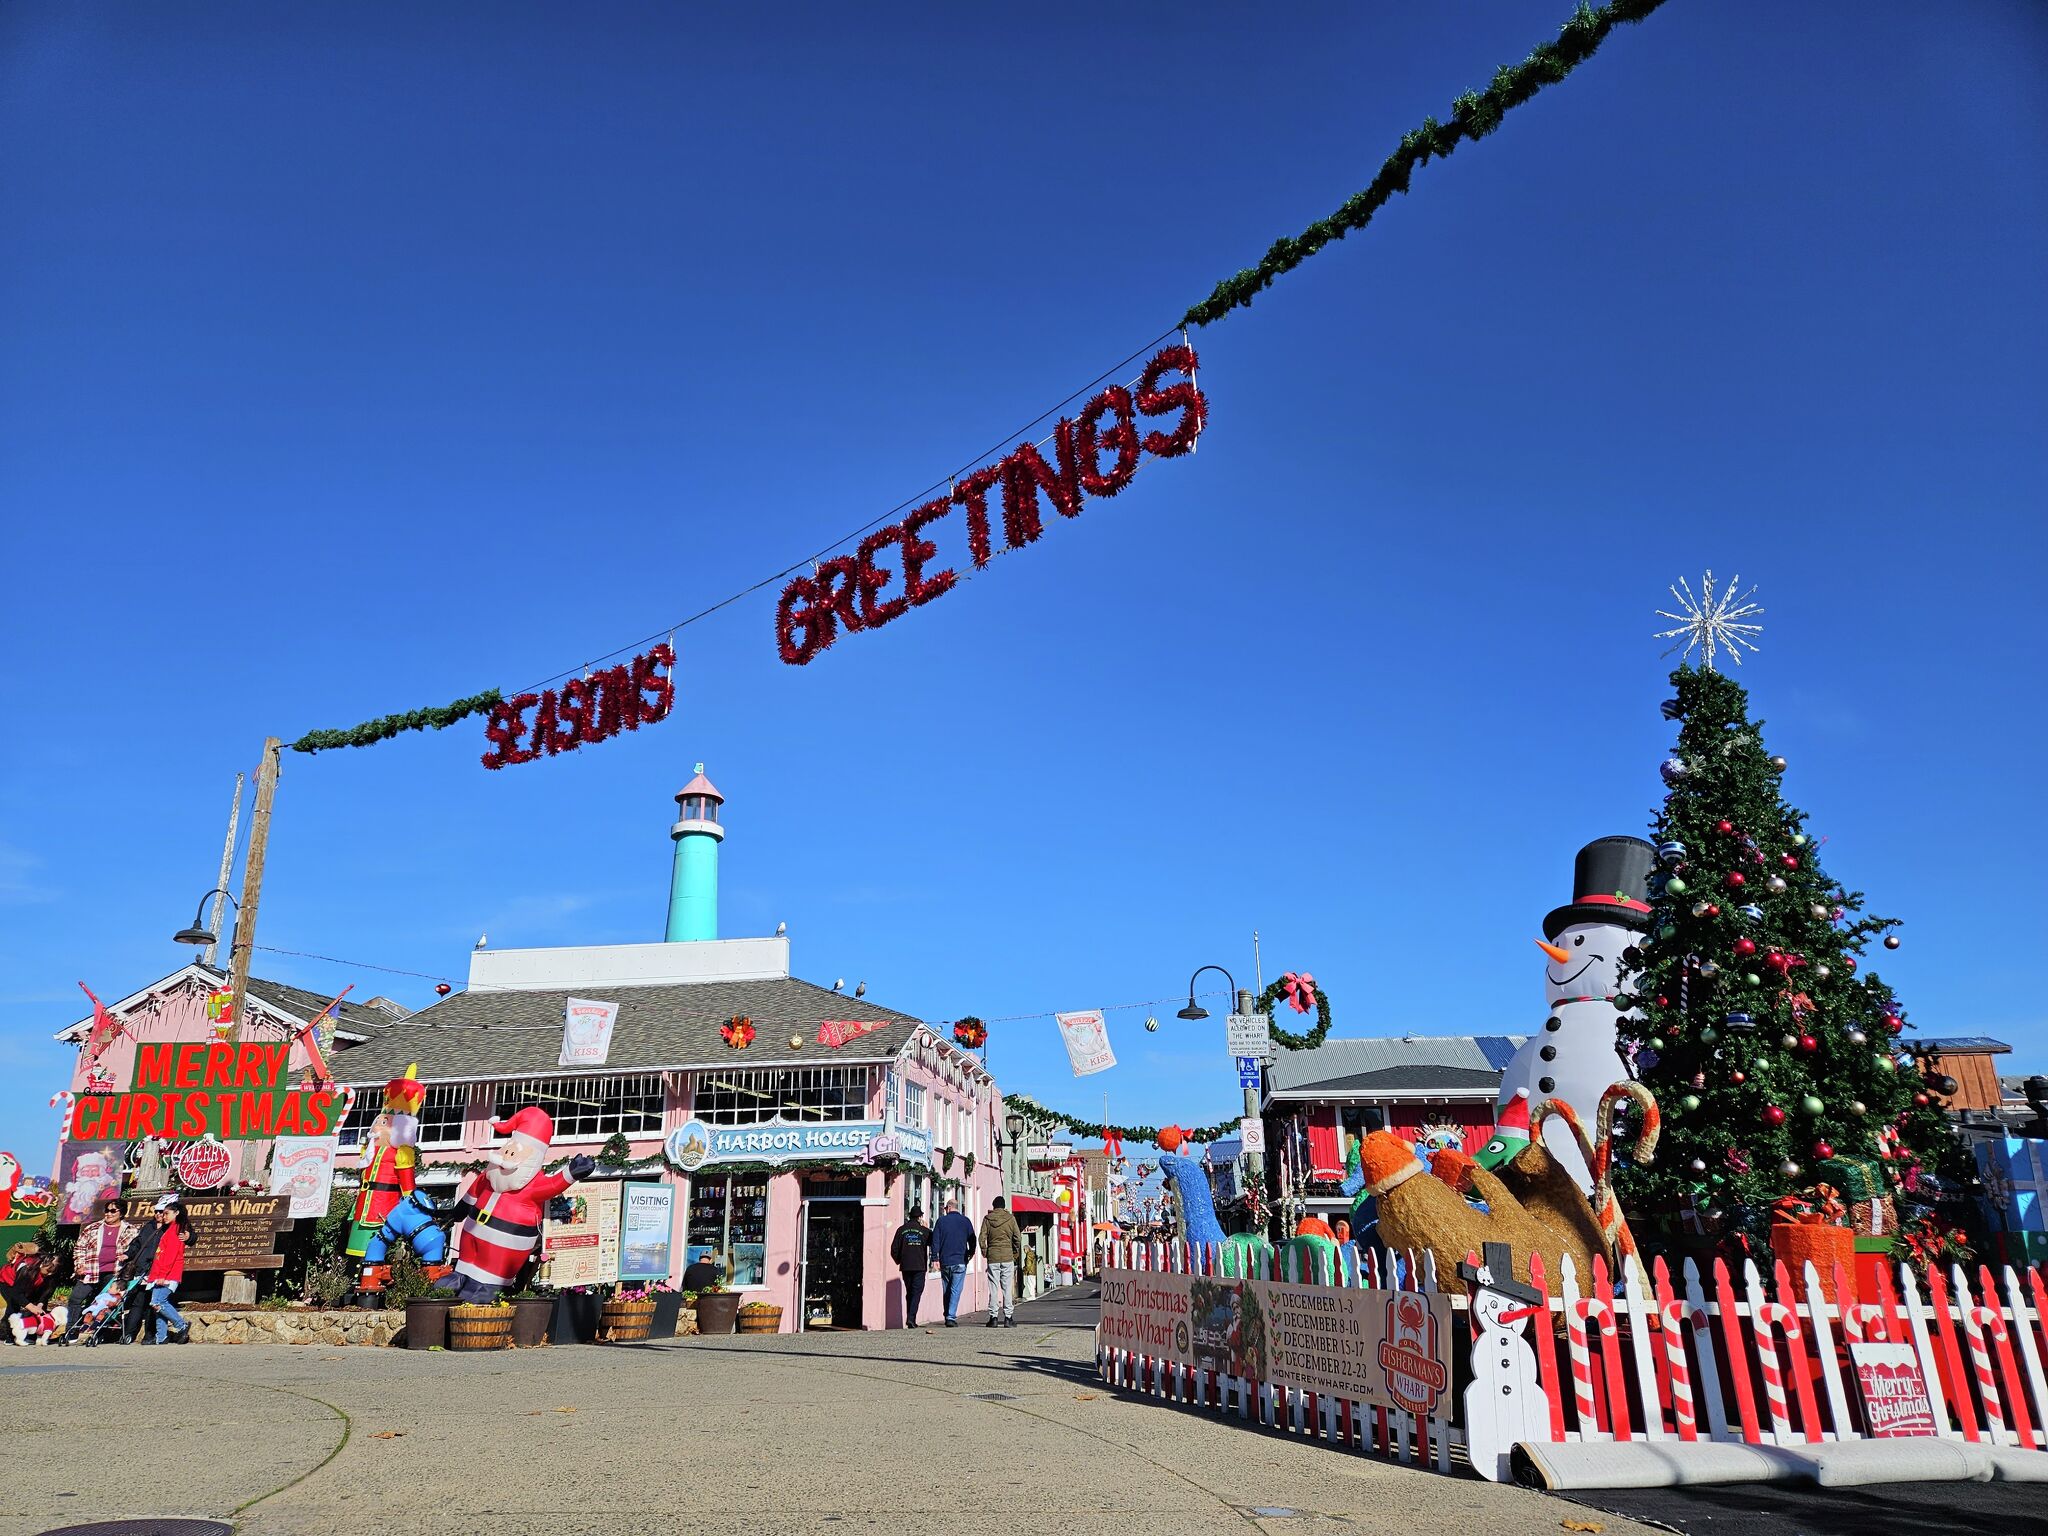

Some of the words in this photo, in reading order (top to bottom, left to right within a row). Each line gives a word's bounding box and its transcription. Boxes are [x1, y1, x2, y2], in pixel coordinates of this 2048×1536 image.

[481, 643, 676, 769] SEASONS
[776, 344, 1208, 665] GREETINGS
[574, 1048, 598, 1056] KISS
[1090, 1053, 1109, 1066] KISS
[137, 1044, 290, 1088] MERRY
[71, 1091, 332, 1140] CHRISTMAS
[183, 1145, 226, 1163] MERRY
[716, 1132, 801, 1152] HARBOR
[806, 1131, 871, 1148] HOUSE
[181, 1161, 230, 1186] Christmas
[230, 1198, 278, 1215] Wharf
[630, 1196, 668, 1206] VISITING
[1103, 1280, 1125, 1305] 2023
[1126, 1279, 1188, 1314] Christmas
[1282, 1293, 1335, 1312] DECEMBER
[1338, 1298, 1354, 1314] 1-3
[1103, 1315, 1115, 1335] on
[1116, 1311, 1134, 1339] the
[1134, 1313, 1174, 1350] Wharf
[1284, 1312, 1338, 1333] DECEMBER
[1339, 1319, 1359, 1336] 8-10
[1284, 1332, 1340, 1354] DECEMBER
[1341, 1339, 1364, 1357] 15-17
[1404, 1340, 1418, 1350] OLD
[1285, 1351, 1340, 1375] DECEMBER
[1342, 1360, 1367, 1379] 22-23
[1382, 1348, 1440, 1384] FISHERMAN'S
[1272, 1368, 1374, 1396] MONTEREYWHARF.COM
[1396, 1374, 1426, 1398] WHARF
[1871, 1374, 1916, 1399] Merry
[1396, 1392, 1424, 1412] MONTEREY
[1868, 1397, 1930, 1423] Christmas
